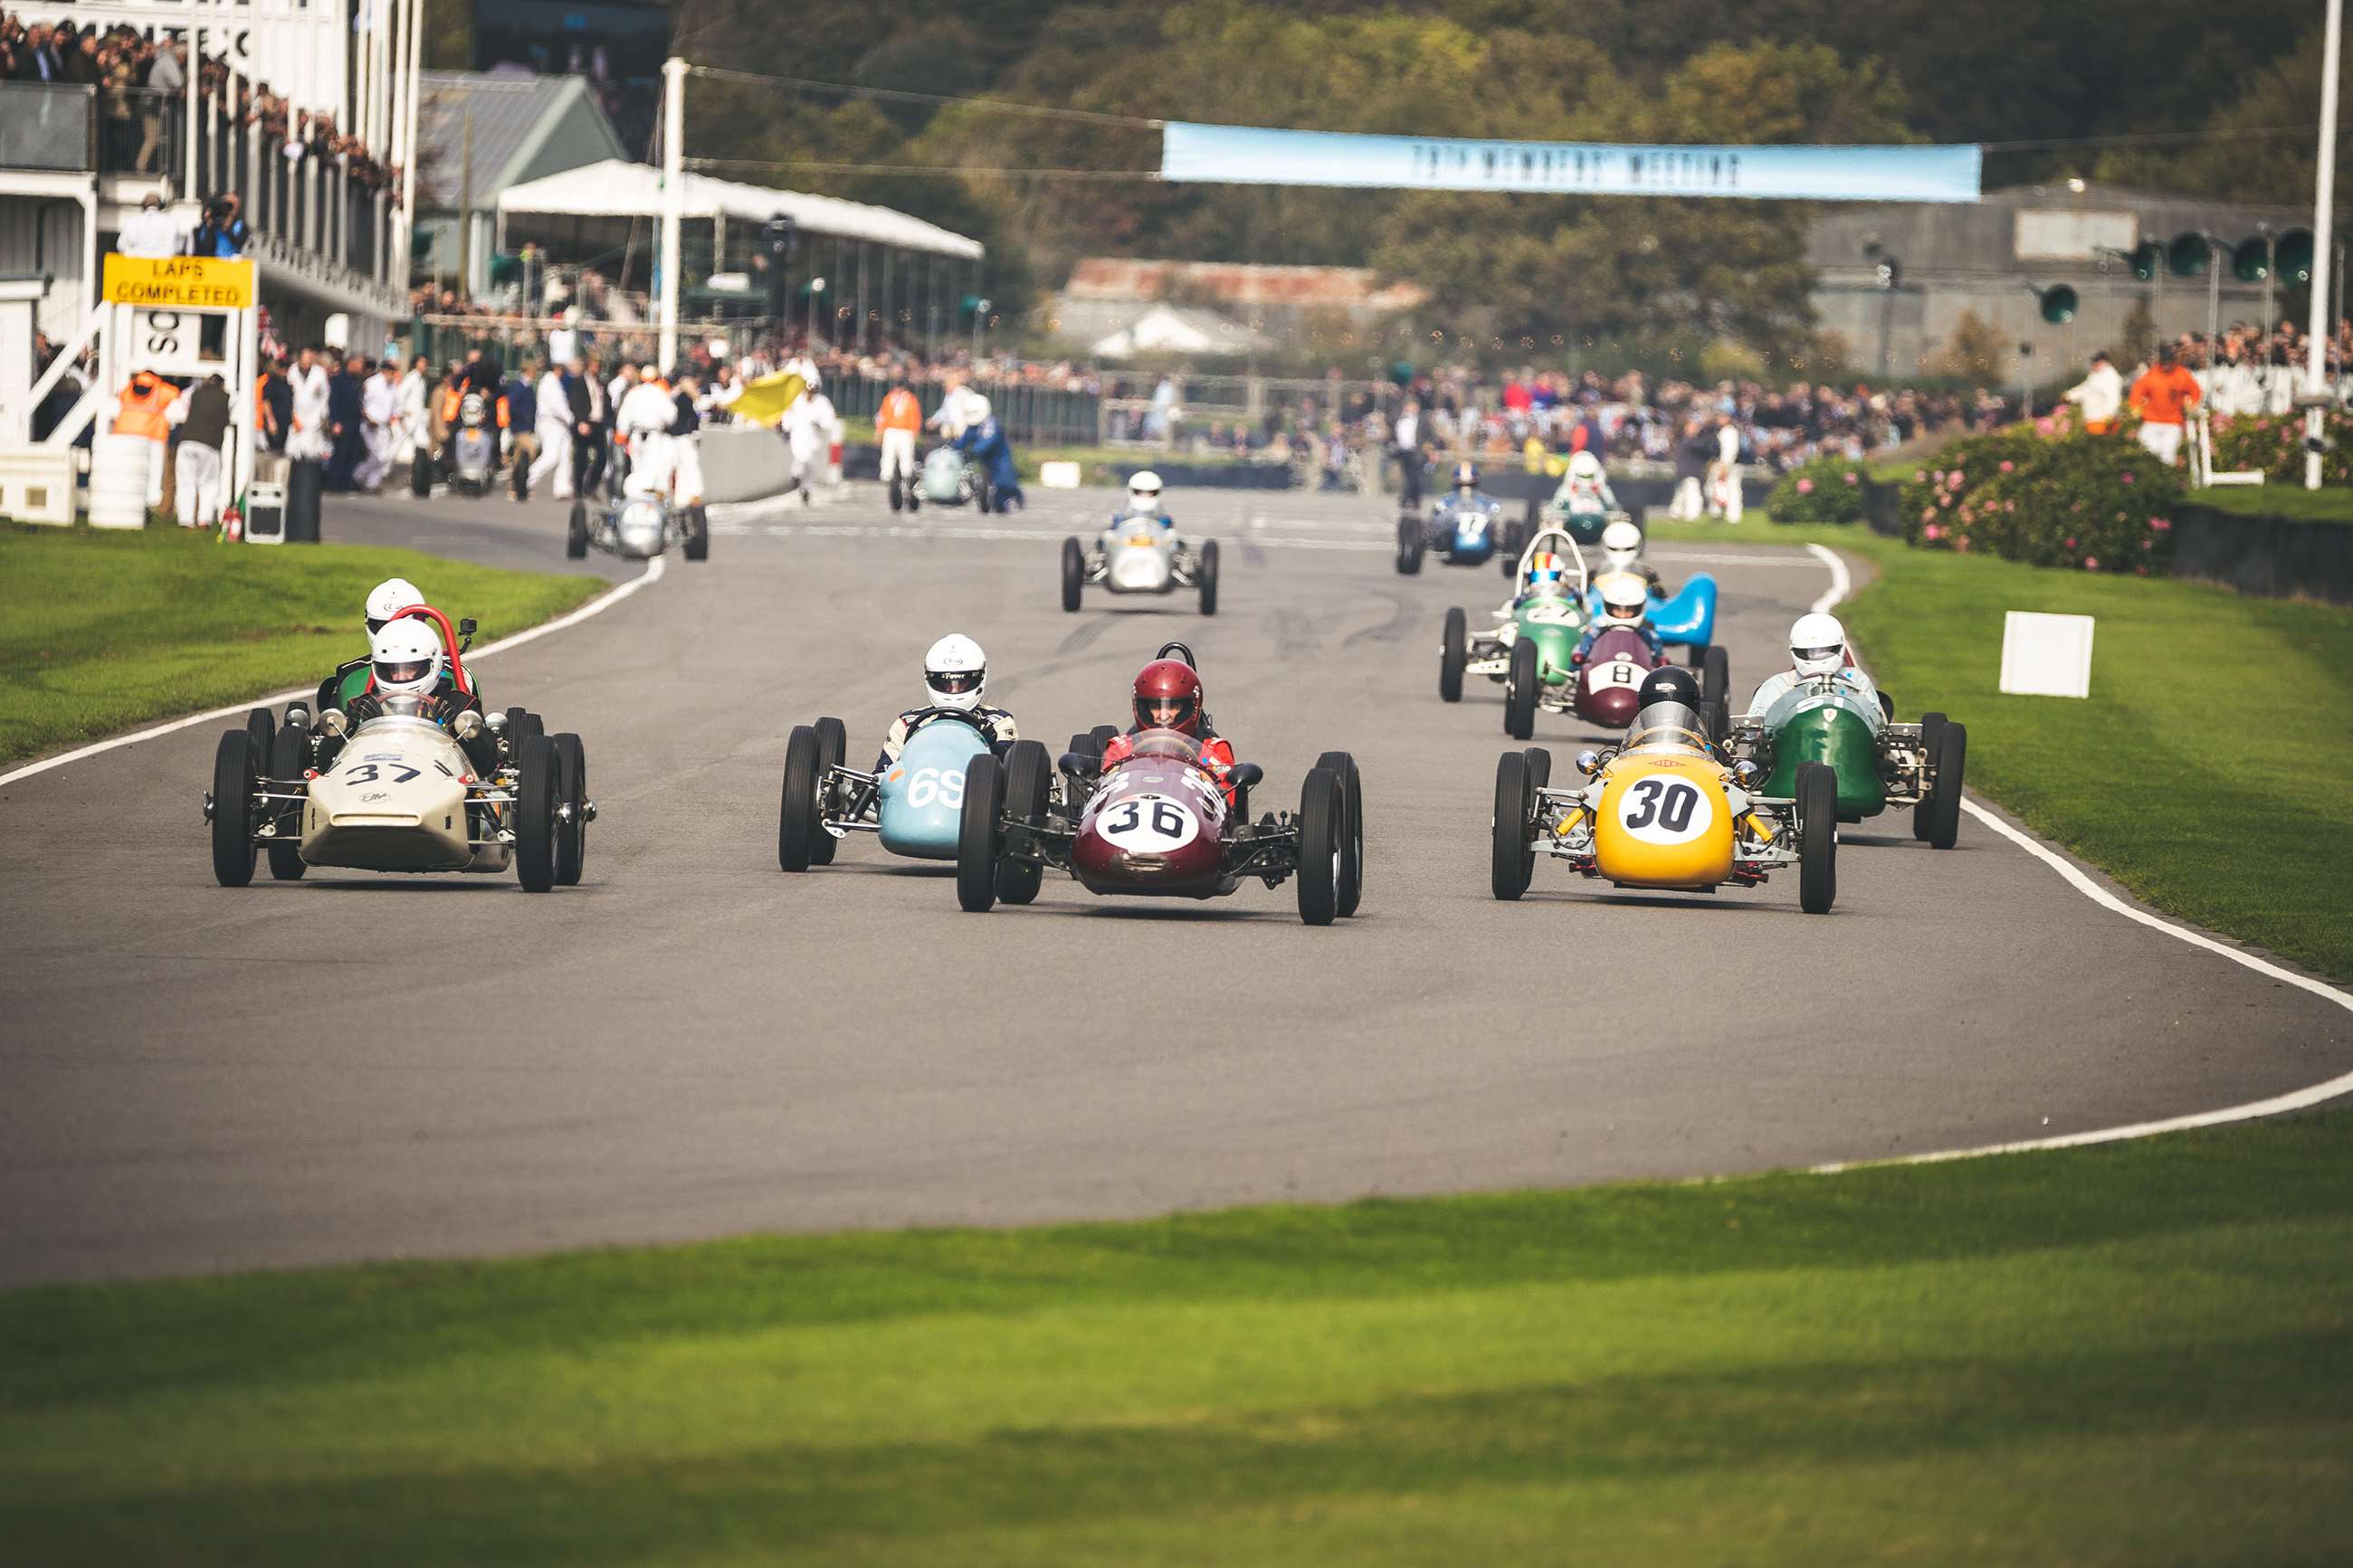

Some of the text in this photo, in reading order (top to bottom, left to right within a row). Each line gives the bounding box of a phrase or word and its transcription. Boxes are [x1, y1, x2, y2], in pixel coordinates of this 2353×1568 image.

[152, 259, 205, 278] LAPS
[116, 281, 240, 303] COMPLETED
[1612, 664, 1632, 684] 8
[346, 764, 421, 786] 37
[908, 767, 966, 809] 69
[1626, 780, 1699, 833] 30
[1107, 801, 1186, 839] 36
